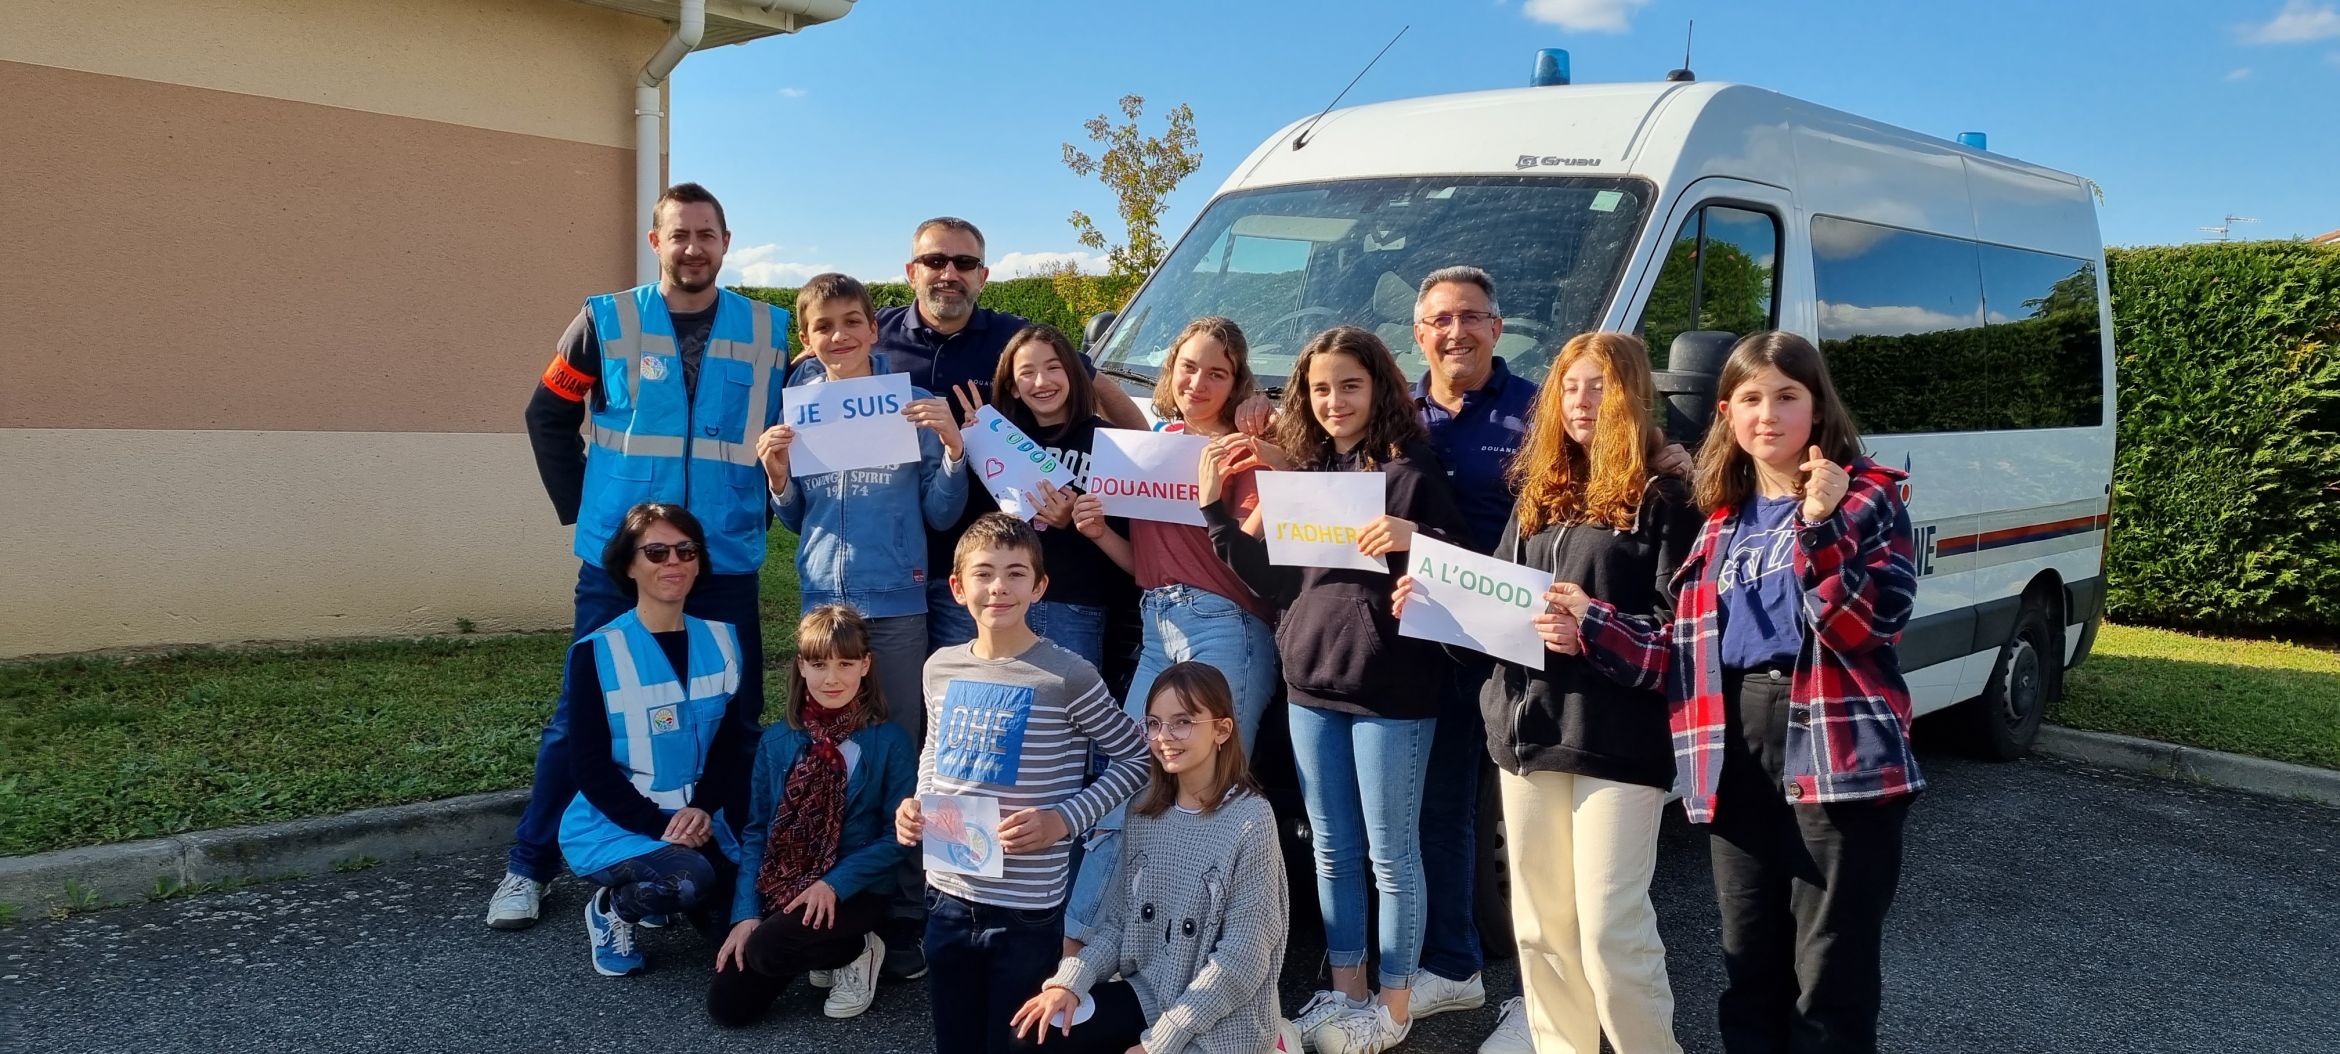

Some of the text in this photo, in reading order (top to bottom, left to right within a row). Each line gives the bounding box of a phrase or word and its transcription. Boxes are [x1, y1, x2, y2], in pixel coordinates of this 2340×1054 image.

[797, 394, 899, 425] JE SUIS
[851, 471, 892, 485] SPIRIT
[1090, 476, 1200, 501] DOUANIER
[1276, 522, 1360, 545] J'ADHER
[1418, 556, 1533, 609] A L'ODOD
